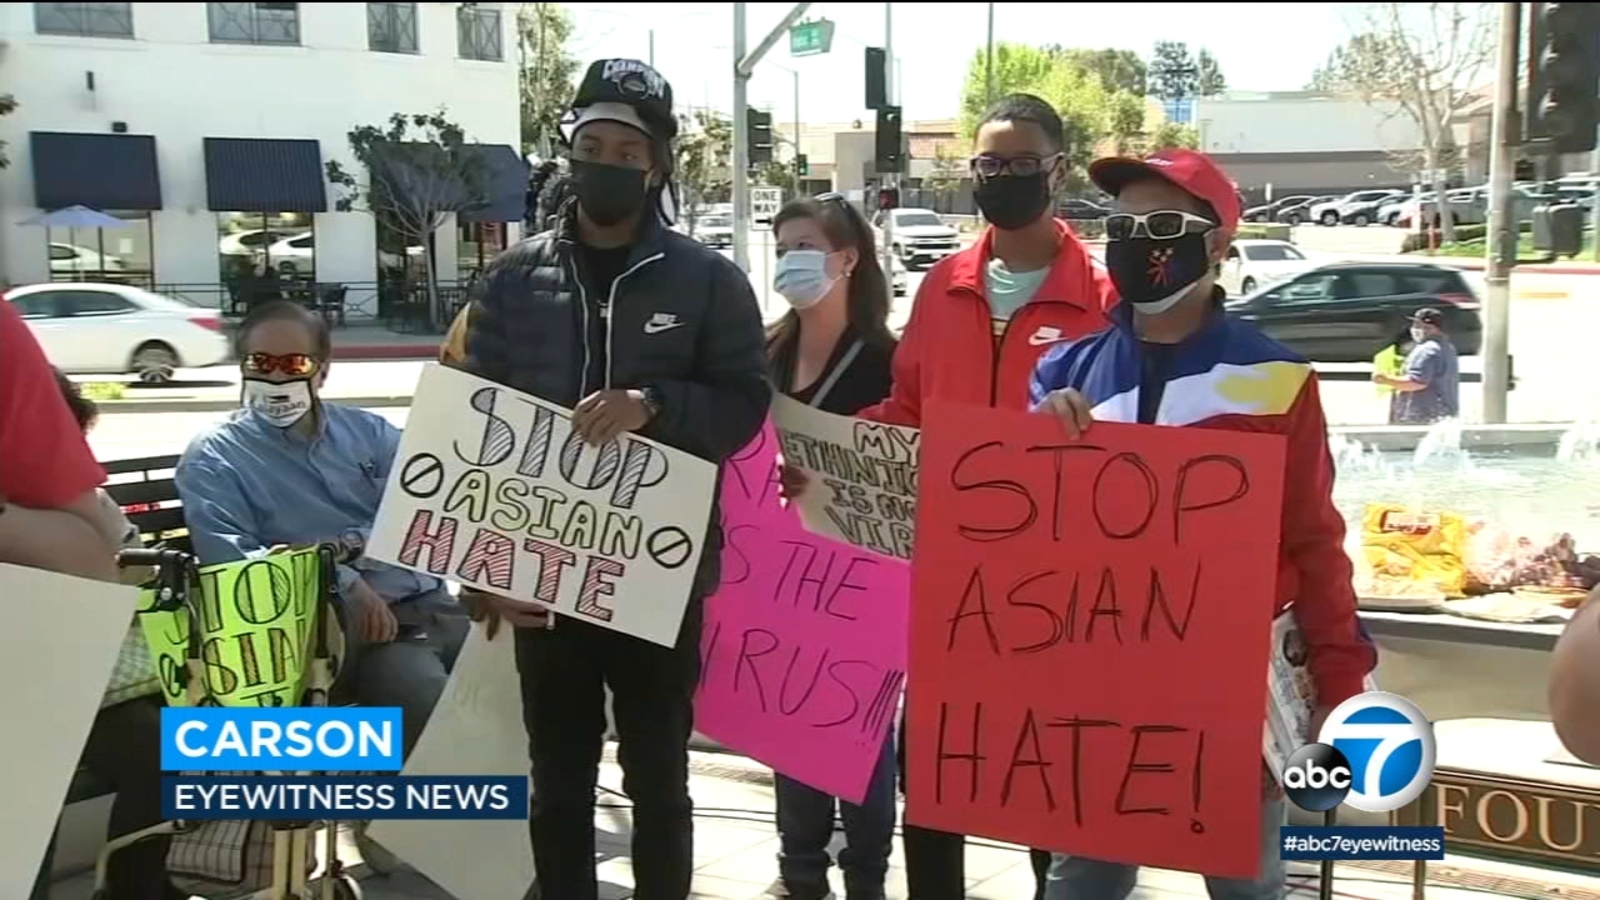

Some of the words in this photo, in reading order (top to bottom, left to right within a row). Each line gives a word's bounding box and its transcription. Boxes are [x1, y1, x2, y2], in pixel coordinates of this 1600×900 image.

[752, 190, 778, 201] ONE
[754, 203, 777, 214] WAY
[453, 386, 669, 510] STOP
[854, 421, 920, 469] MY
[444, 469, 642, 560] ASIAN
[822, 478, 874, 515] IS
[950, 440, 1249, 546] STOP
[398, 509, 625, 622] HATE
[774, 540, 880, 622] THE
[946, 560, 1201, 652] ASIAN
[935, 701, 1206, 834] HATE!
[1431, 782, 1600, 853] FOU
